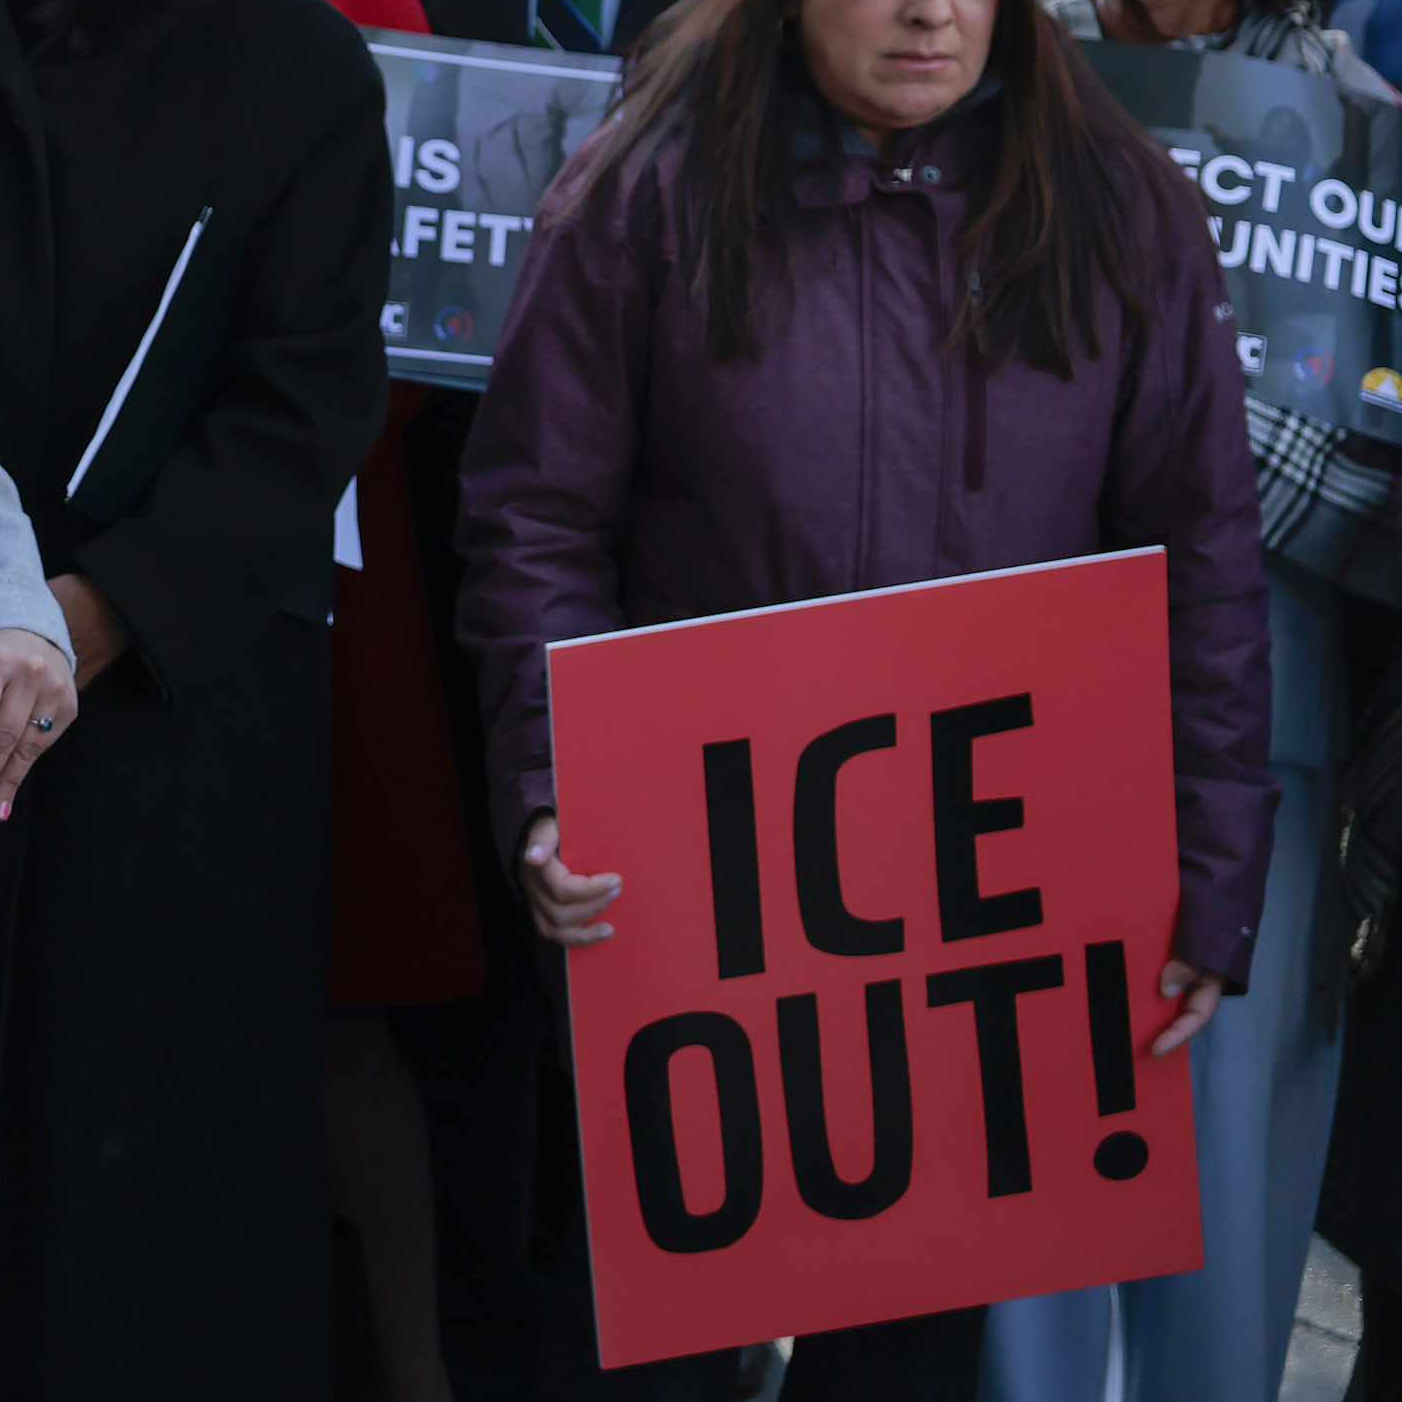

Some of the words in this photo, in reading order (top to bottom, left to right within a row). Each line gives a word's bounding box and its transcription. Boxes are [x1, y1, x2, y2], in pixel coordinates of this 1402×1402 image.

[390, 205, 534, 268] FET
[1308, 178, 1402, 250] OU
[1207, 216, 1402, 310] UNITIE
[702, 691, 1044, 981] ICE
[623, 938, 1151, 1255] OUT!
